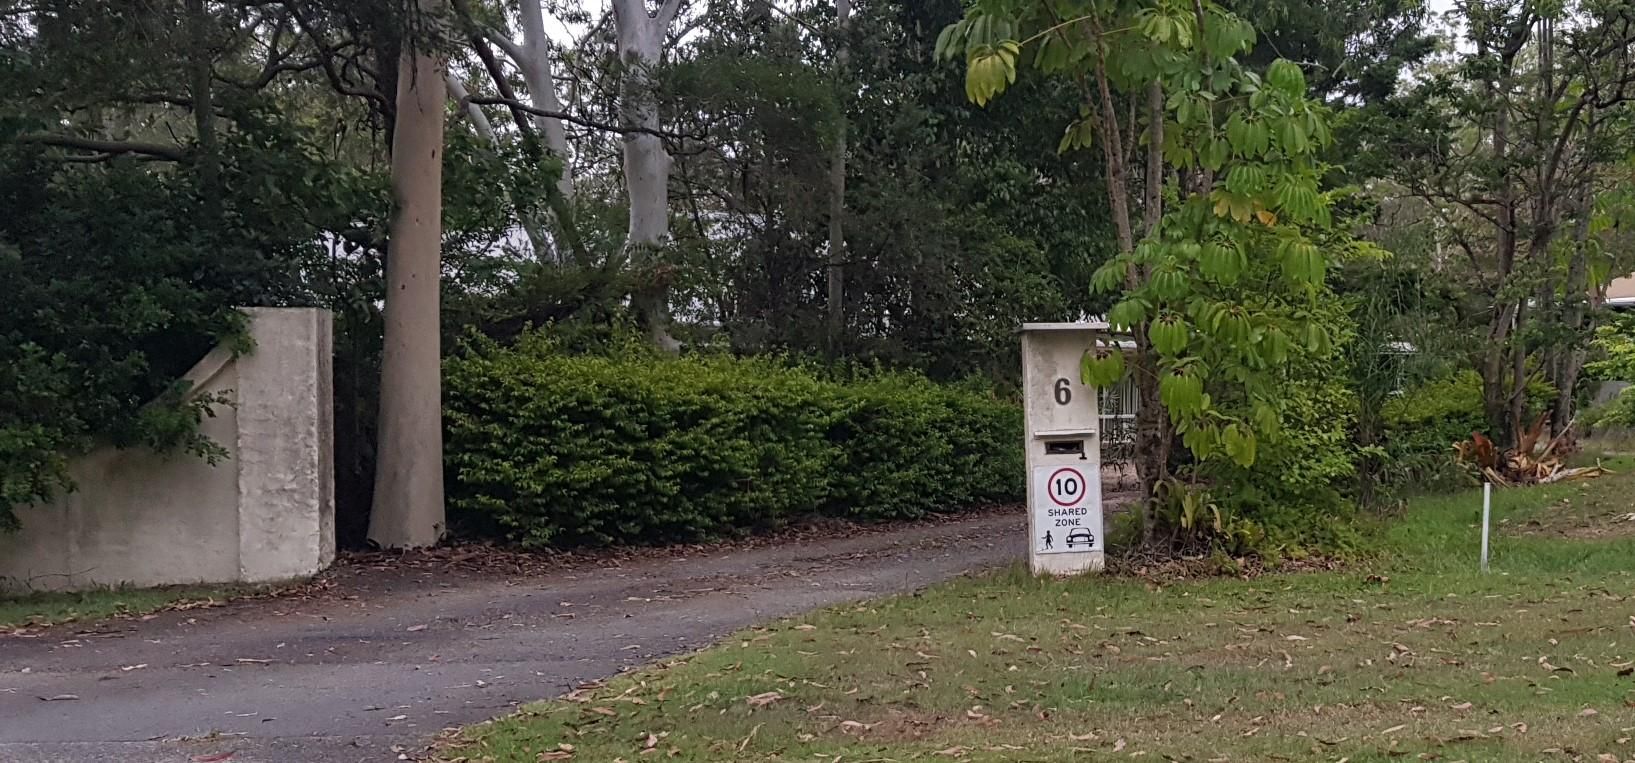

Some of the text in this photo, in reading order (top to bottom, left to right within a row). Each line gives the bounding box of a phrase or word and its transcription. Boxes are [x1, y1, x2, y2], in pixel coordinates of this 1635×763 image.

[1054, 378, 1072, 406] 6
[1055, 478, 1078, 496] 10
[1047, 507, 1088, 517] SHARED
[1055, 518, 1081, 527] ZONE
